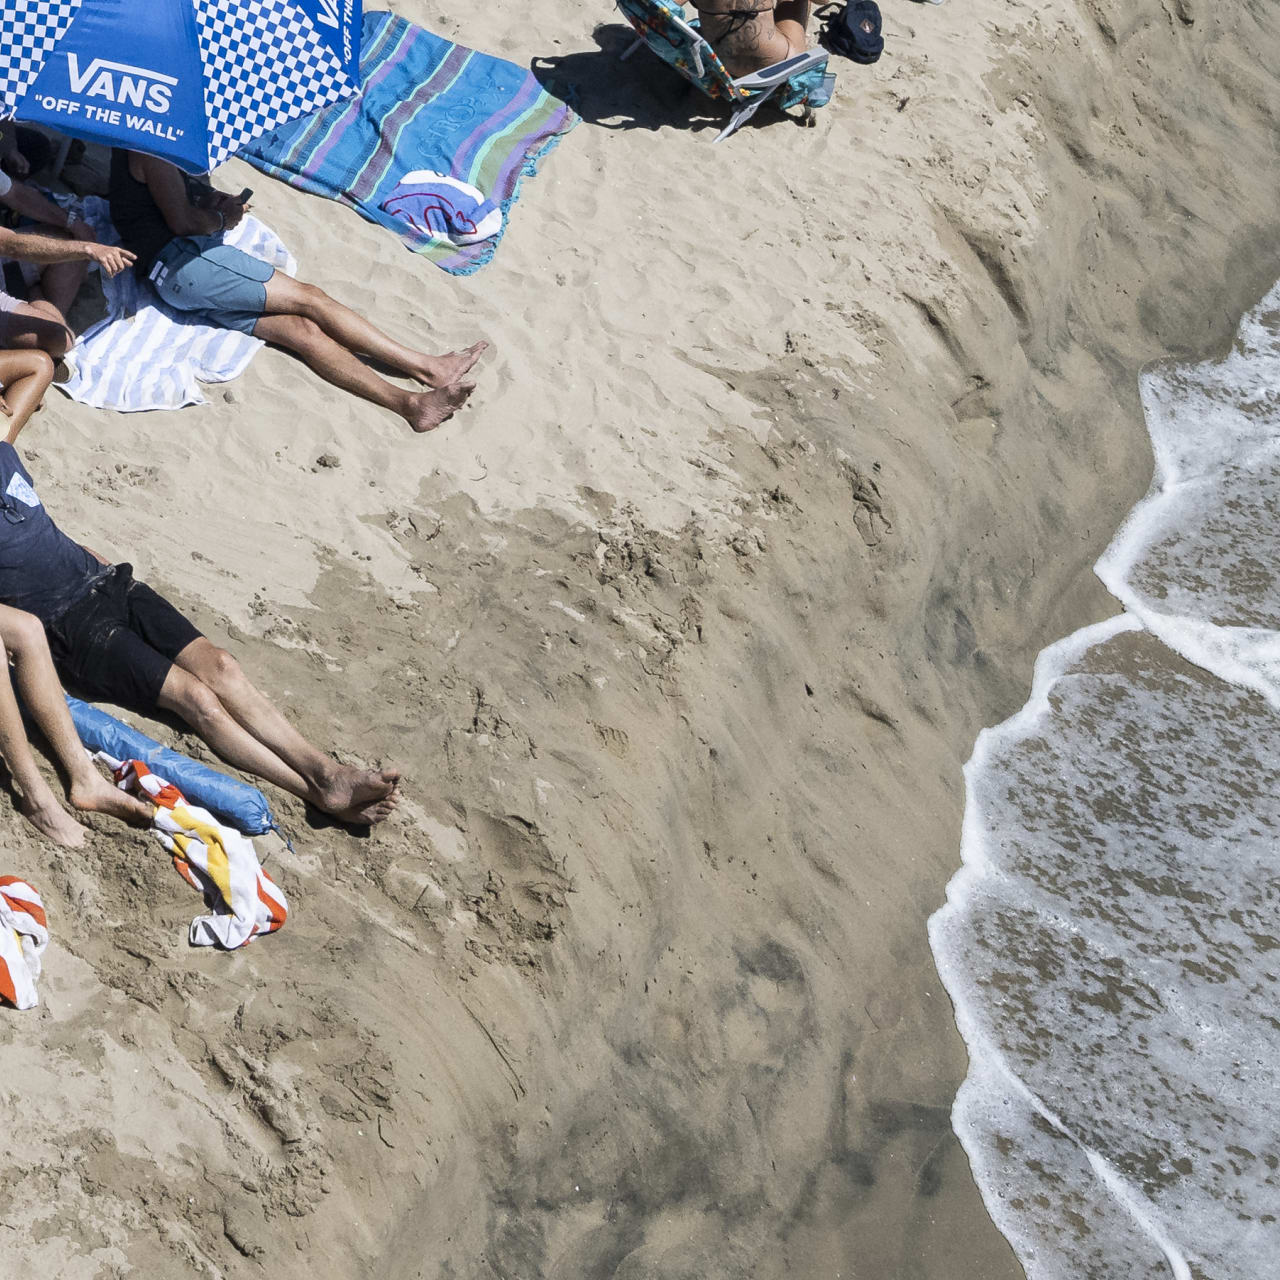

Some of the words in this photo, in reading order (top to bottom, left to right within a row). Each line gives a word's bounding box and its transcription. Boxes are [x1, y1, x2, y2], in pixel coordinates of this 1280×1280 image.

[344, 3, 355, 31] THE
[341, 32, 354, 66] "OFF
[67, 53, 178, 115] VANS
[35, 94, 81, 116] "OFF
[85, 104, 122, 127] THE
[125, 114, 184, 141] WALL"
